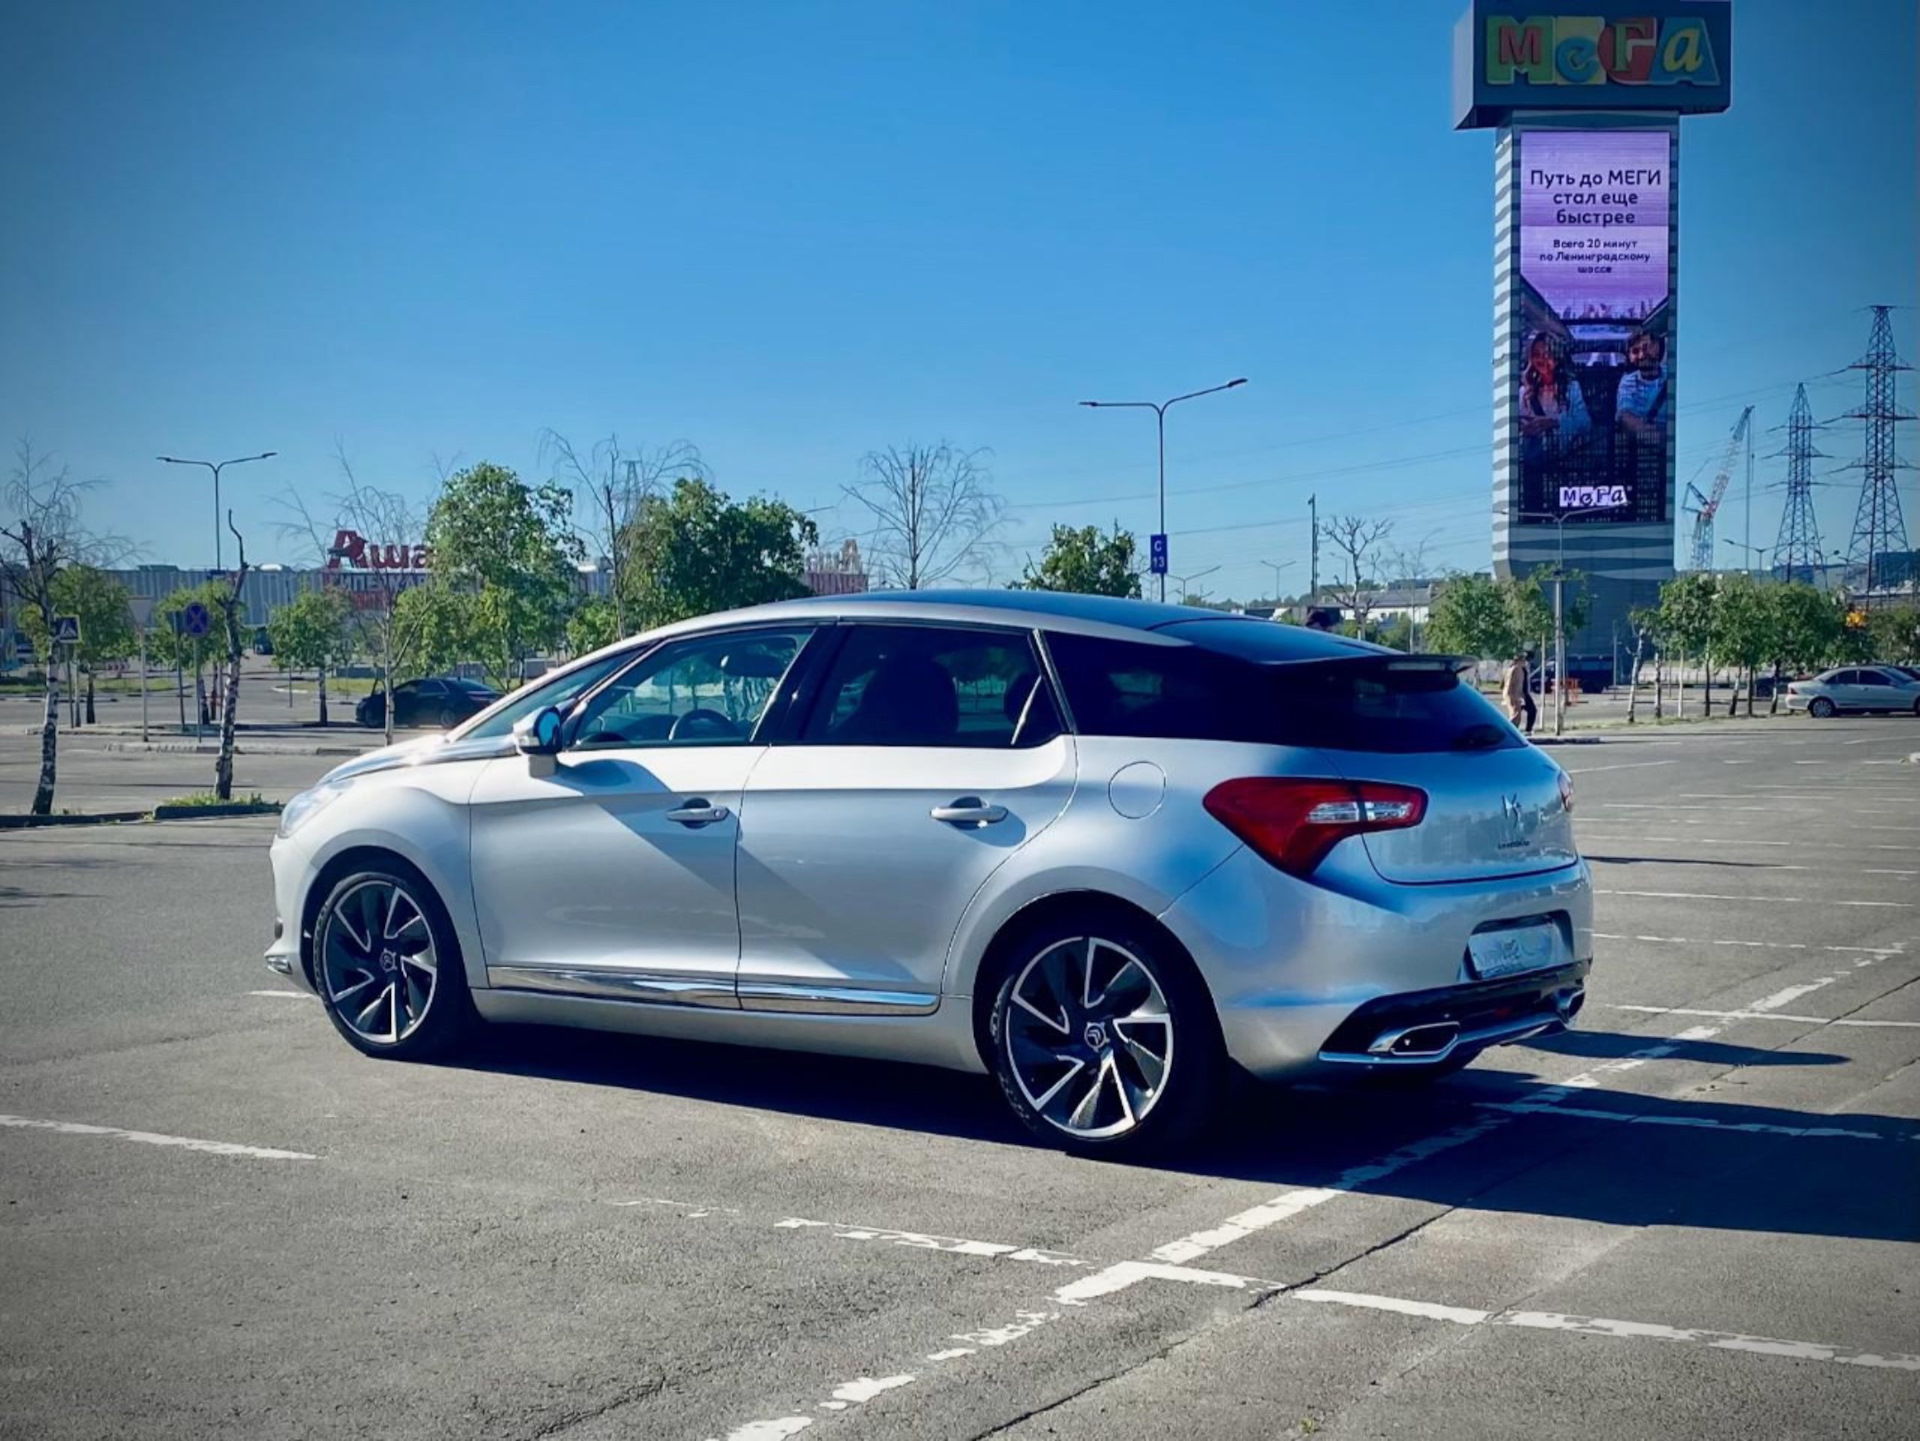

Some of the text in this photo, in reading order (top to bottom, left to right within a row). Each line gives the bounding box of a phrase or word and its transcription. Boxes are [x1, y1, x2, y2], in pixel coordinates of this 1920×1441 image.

[1530, 169, 1661, 189] Путь до МЕГИ
[1553, 192, 1639, 207] стал еще
[1556, 208, 1636, 228] быстрее
[1553, 238, 1638, 250] Всего 20 минут
[1539, 251, 1651, 263] по Ленинградскому
[327, 530, 434, 569] Аша
[1152, 556, 1165, 568] 13
